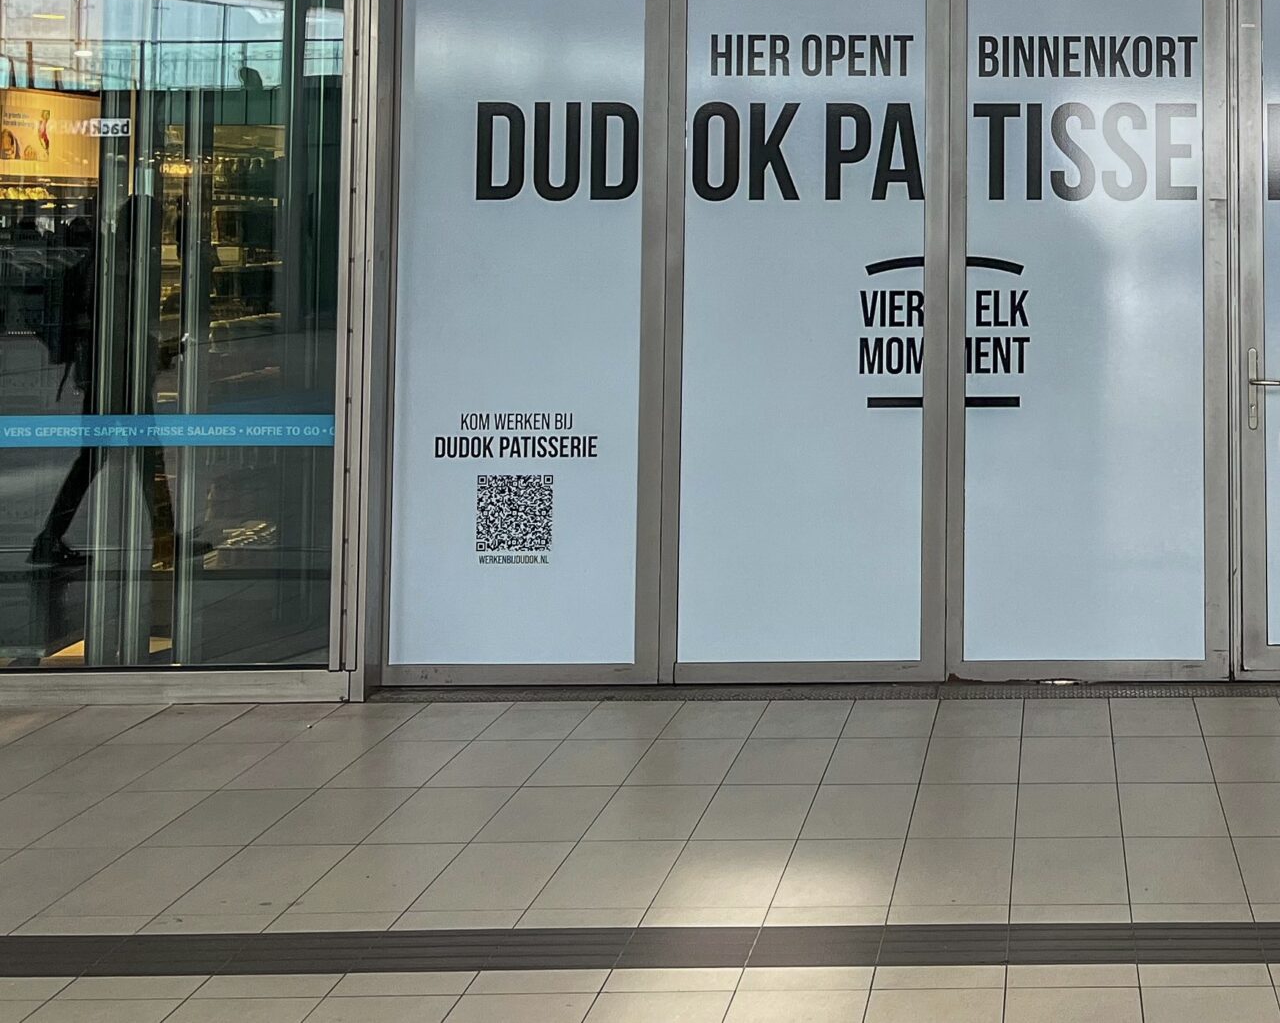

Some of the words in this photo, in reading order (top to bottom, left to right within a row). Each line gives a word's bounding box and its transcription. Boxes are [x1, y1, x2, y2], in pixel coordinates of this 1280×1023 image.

[710, 34, 790, 77] HIER
[801, 34, 914, 77] OPENT
[978, 34, 1199, 79] BINNENKORT
[475, 101, 801, 202] DUDOK
[859, 290, 924, 328] VIER
[975, 289, 1030, 327] ELK
[858, 336, 1031, 375] MOMENT
[3, 427, 32, 437] VERS
[35, 427, 91, 437] GEPERSTE
[93, 426, 137, 437] SAPPEN
[147, 426, 184, 436] FRISSE
[187, 426, 236, 436] SALADES
[246, 426, 283, 436] KOFFIE
[286, 426, 301, 436] TO
[303, 426, 320, 436] GO
[460, 412, 490, 431] KOM
[494, 412, 551, 431] WERKEN
[554, 412, 573, 430] BIJ
[434, 435, 495, 459] DUDOK
[499, 435, 599, 458] PATISSERIE
[478, 554, 550, 565] WERKENBIJDUDOK.NL
